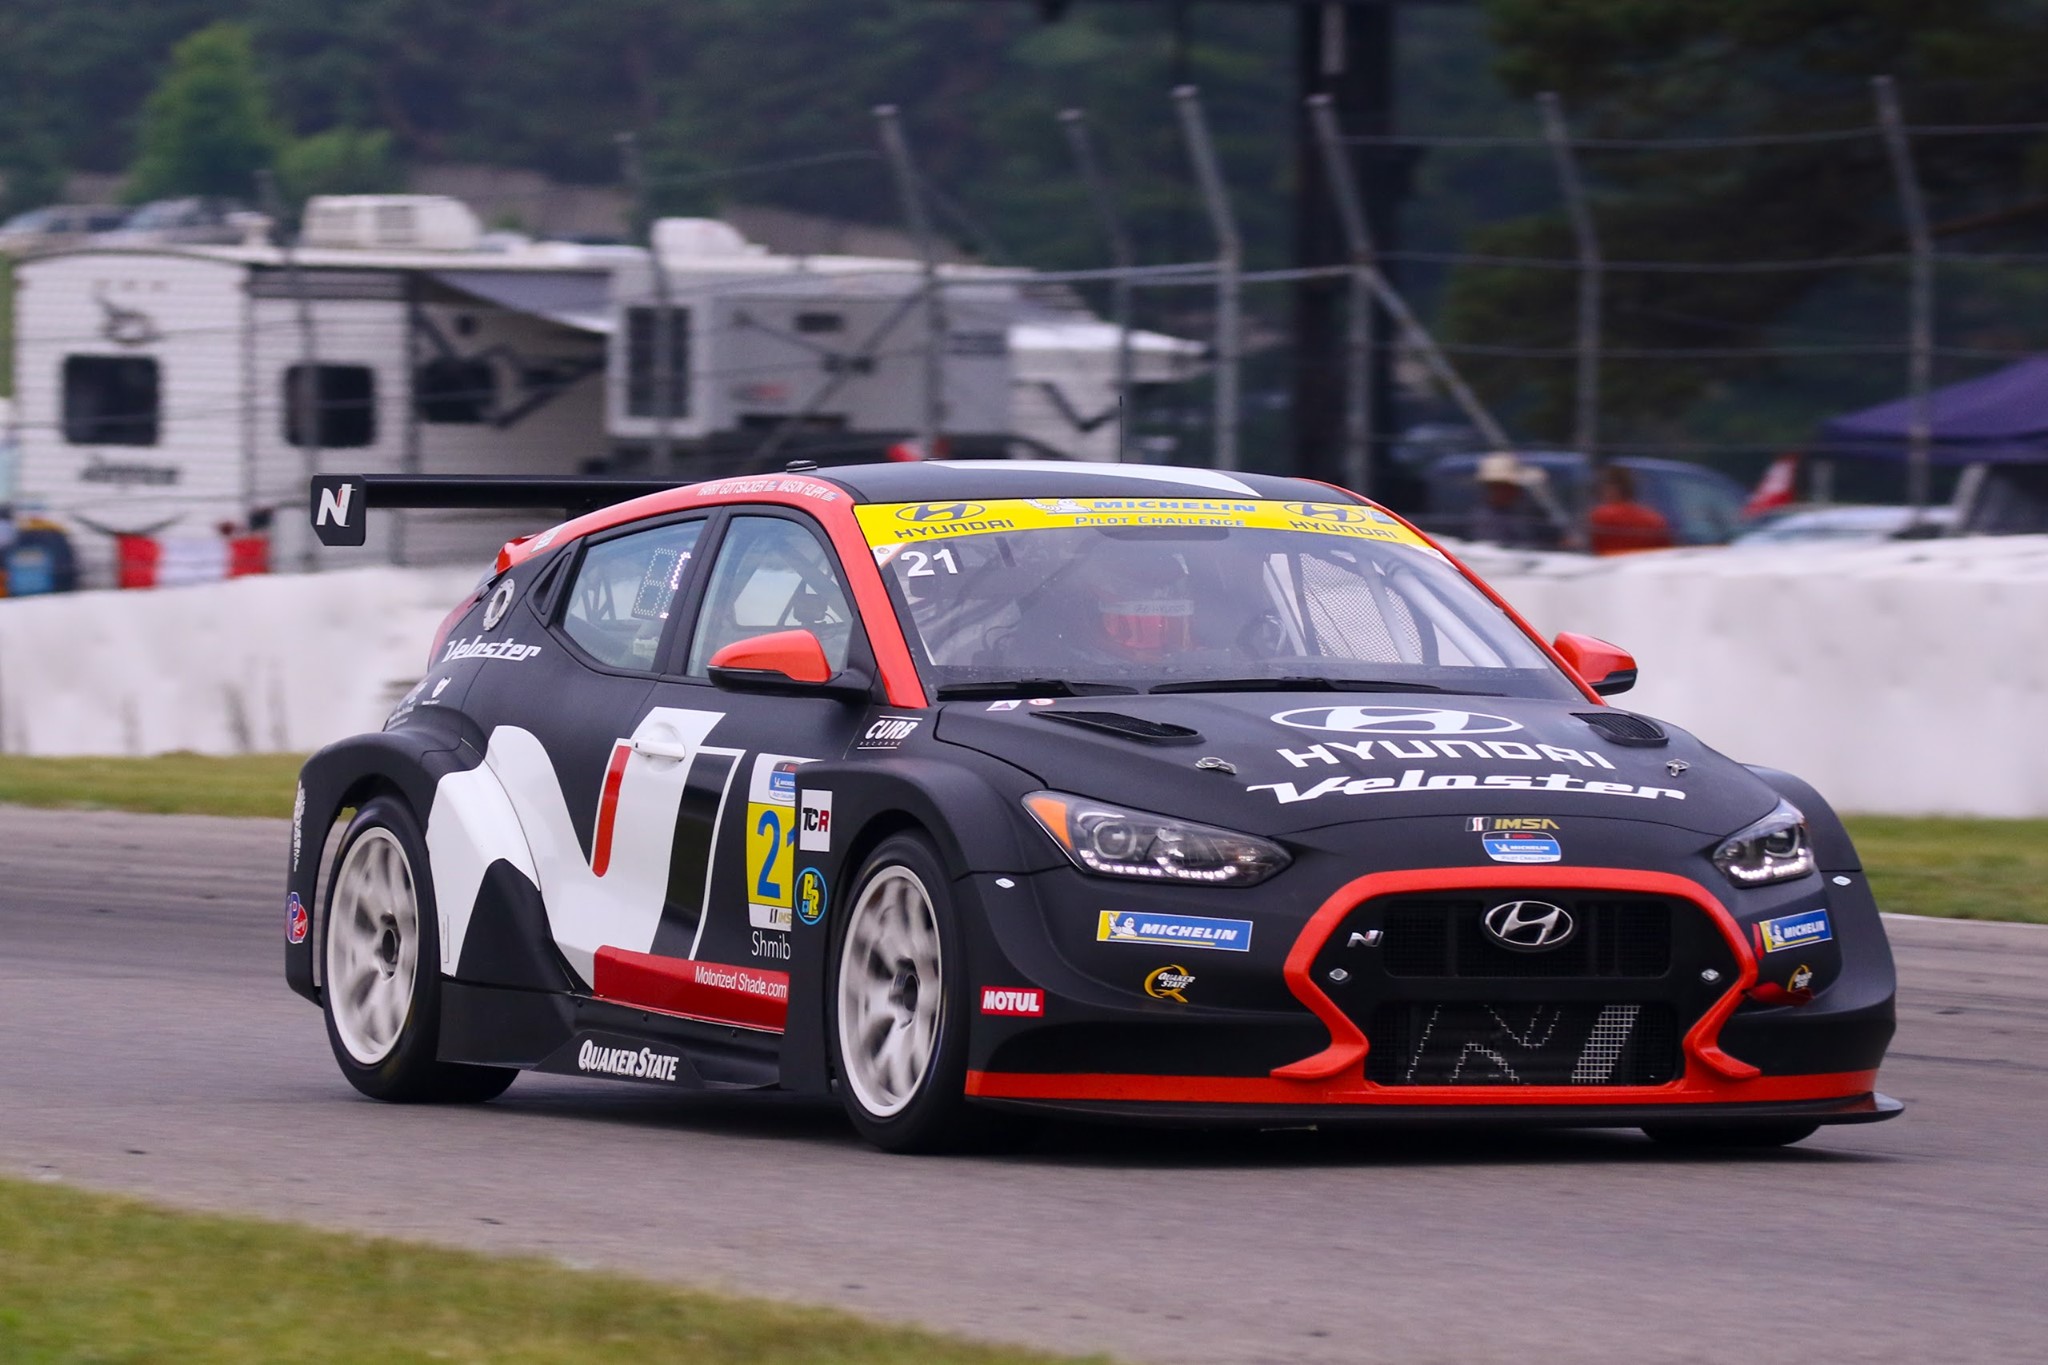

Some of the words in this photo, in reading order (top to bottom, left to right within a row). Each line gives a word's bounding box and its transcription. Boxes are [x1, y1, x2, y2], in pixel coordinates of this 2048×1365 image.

[1093, 500, 1256, 512] MICHELIN
[893, 519, 1015, 539] HYUNDAI
[1075, 516, 1128, 525] PILOT
[1138, 515, 1245, 527] CHALLENGE
[1288, 520, 1398, 539] HYUNDAI
[900, 548, 958, 577] 21
[441, 635, 542, 663] Veloster
[865, 719, 918, 740] CURB
[1275, 740, 1616, 770] HYUNDAI
[1246, 769, 1686, 804] Veloster
[802, 807, 830, 832] TCR
[1494, 818, 1560, 830] IMSA
[1140, 922, 1237, 941] MICHELIN
[1783, 920, 1825, 939] MICHELIN
[751, 930, 791, 960] Shmib
[695, 965, 737, 990] Motorized
[738, 973, 787, 998] Shade.com
[1158, 971, 1196, 984] QUAKER
[1160, 980, 1188, 990] STATE
[982, 989, 1040, 1012] MOTUL
